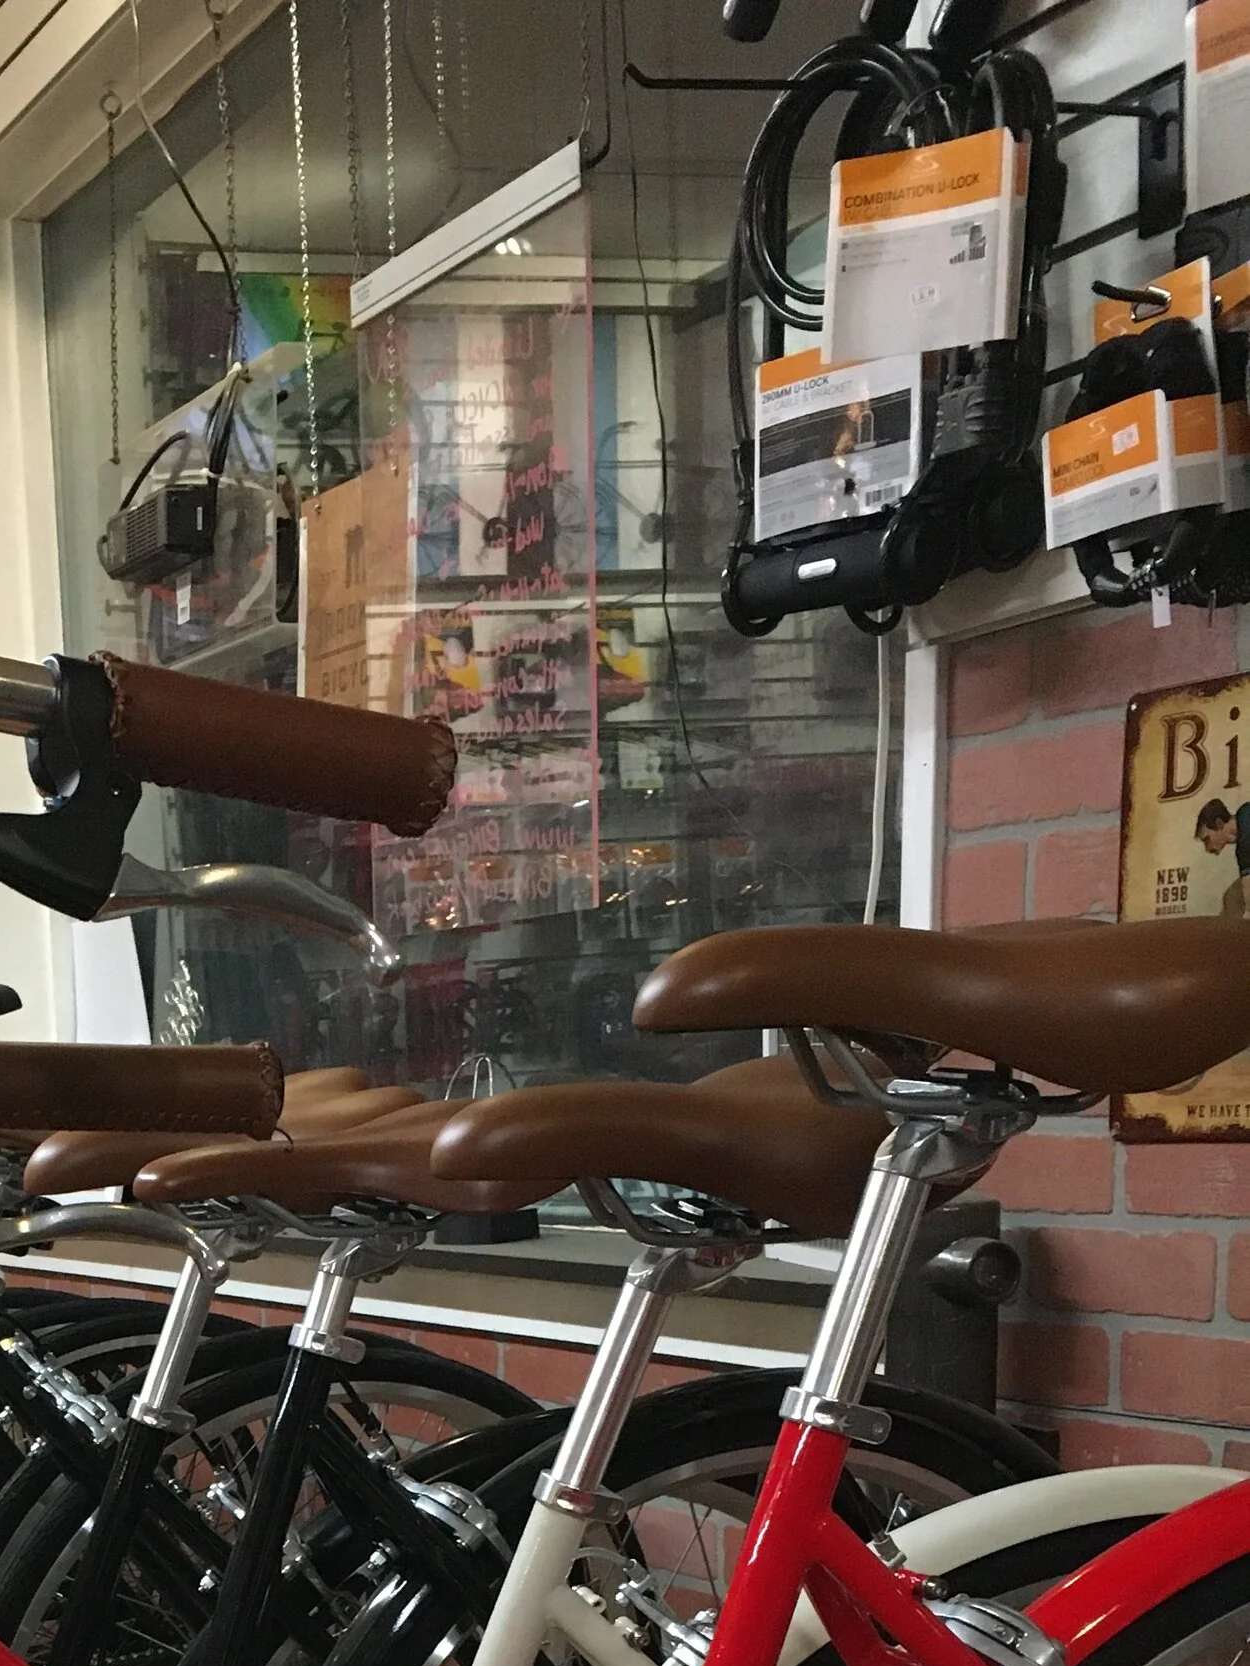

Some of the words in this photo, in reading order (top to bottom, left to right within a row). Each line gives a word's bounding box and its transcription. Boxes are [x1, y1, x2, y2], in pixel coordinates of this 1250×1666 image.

[844, 183, 935, 210] COMBINATION
[937, 172, 981, 193] U-LOCK
[794, 375, 830, 394] U-LOCK
[1156, 866, 1190, 886] NEW
[1155, 886, 1189, 904] 1898
[1187, 1104, 1205, 1118] WE
[1210, 1104, 1241, 1118] HAVE
